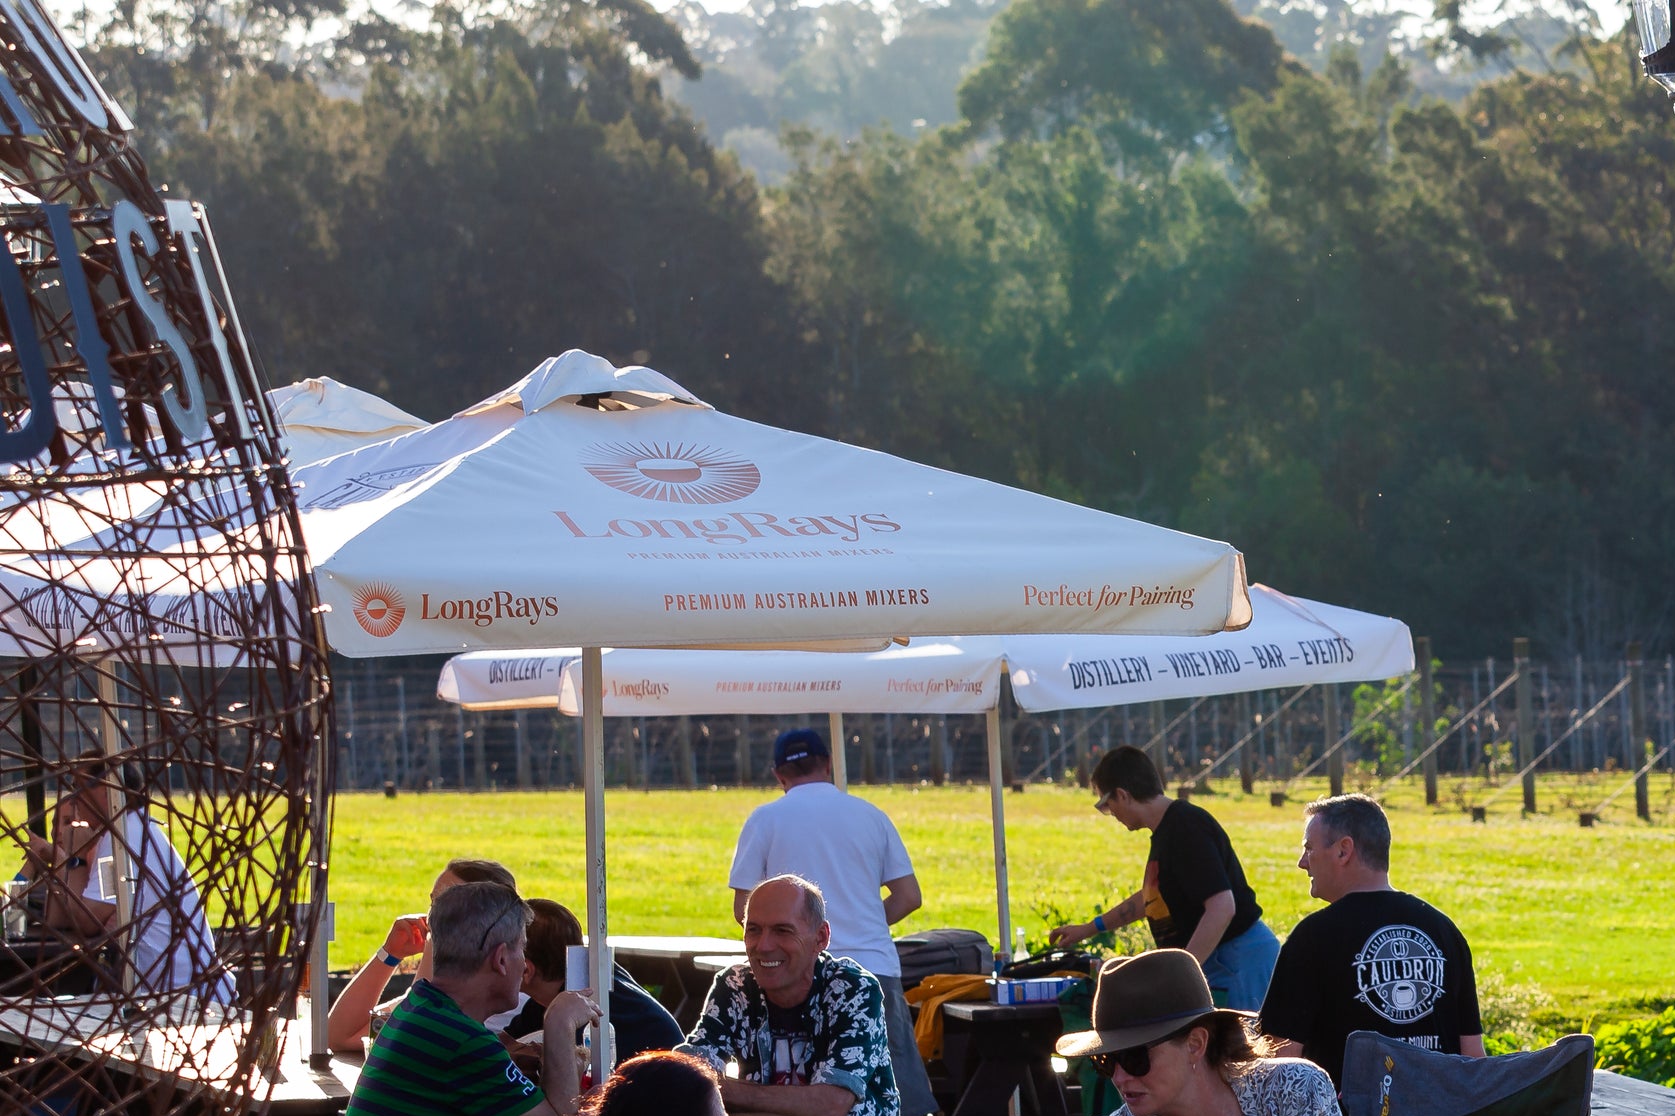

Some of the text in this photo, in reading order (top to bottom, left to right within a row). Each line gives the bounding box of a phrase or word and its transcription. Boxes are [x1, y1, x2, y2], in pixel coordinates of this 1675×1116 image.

[553, 510, 902, 545] LongRays
[626, 548, 895, 560] PREMIUM AUSTRALIAN MIXERS
[421, 590, 559, 627] LongRays
[664, 588, 929, 611] PREMIUM AUSTRALIAN MIXERS
[1023, 584, 1195, 612] Perfect for Pairing
[489, 657, 545, 684] DISTILLERY
[1069, 655, 1153, 690] DISTILLERY
[1166, 649, 1241, 678] VINEYARD
[1251, 643, 1287, 669] BAR
[1298, 637, 1354, 665] EVENTS
[612, 679, 669, 700] LongRays
[715, 680, 842, 693] PREMIUM AUSTRALIAN MIXERS
[887, 678, 983, 697] Perfect for Pairing
[1368, 929, 1432, 954] ESTABLISHED 2020
[1357, 958, 1444, 992] CAULDRON
